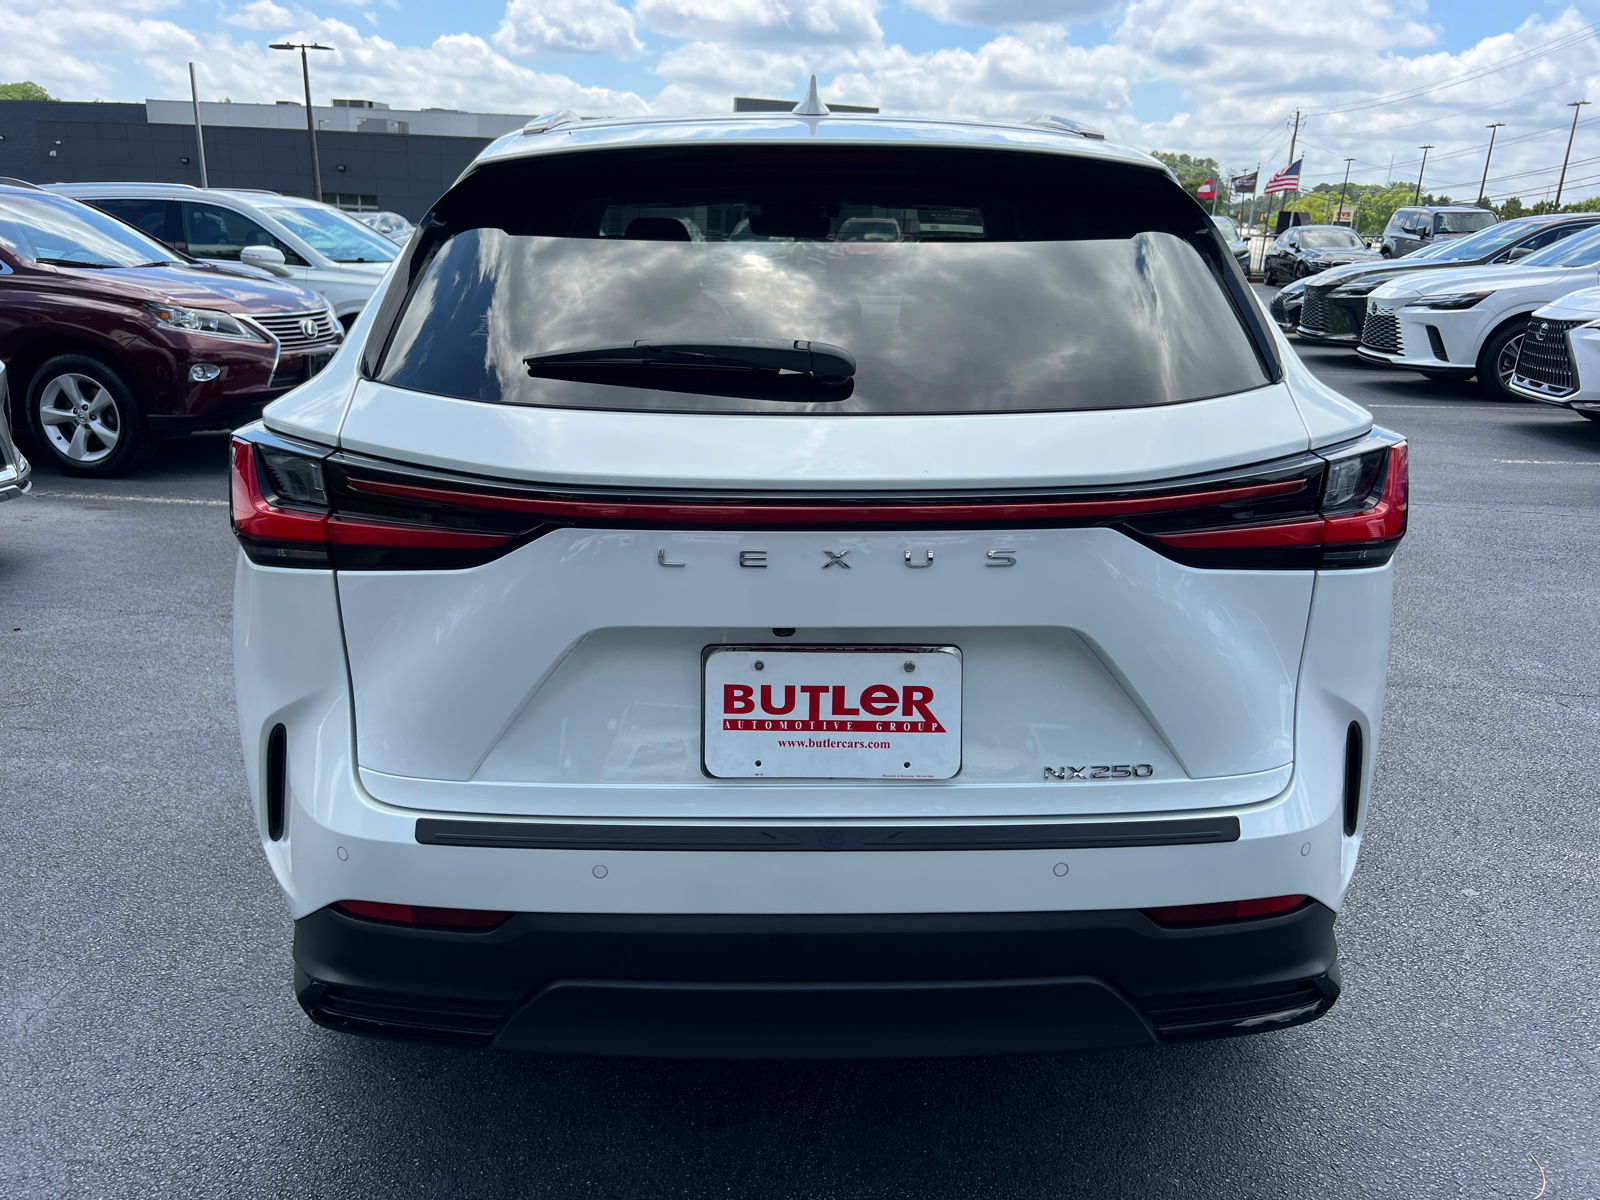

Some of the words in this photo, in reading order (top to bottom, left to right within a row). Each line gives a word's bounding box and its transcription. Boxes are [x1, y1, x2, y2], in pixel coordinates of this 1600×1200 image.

[657, 548, 1017, 569] LEXUS
[724, 720, 854, 731] AUTOMOTIVE
[876, 721, 939, 732] GROUP
[778, 739, 891, 749] www.butlercars.com
